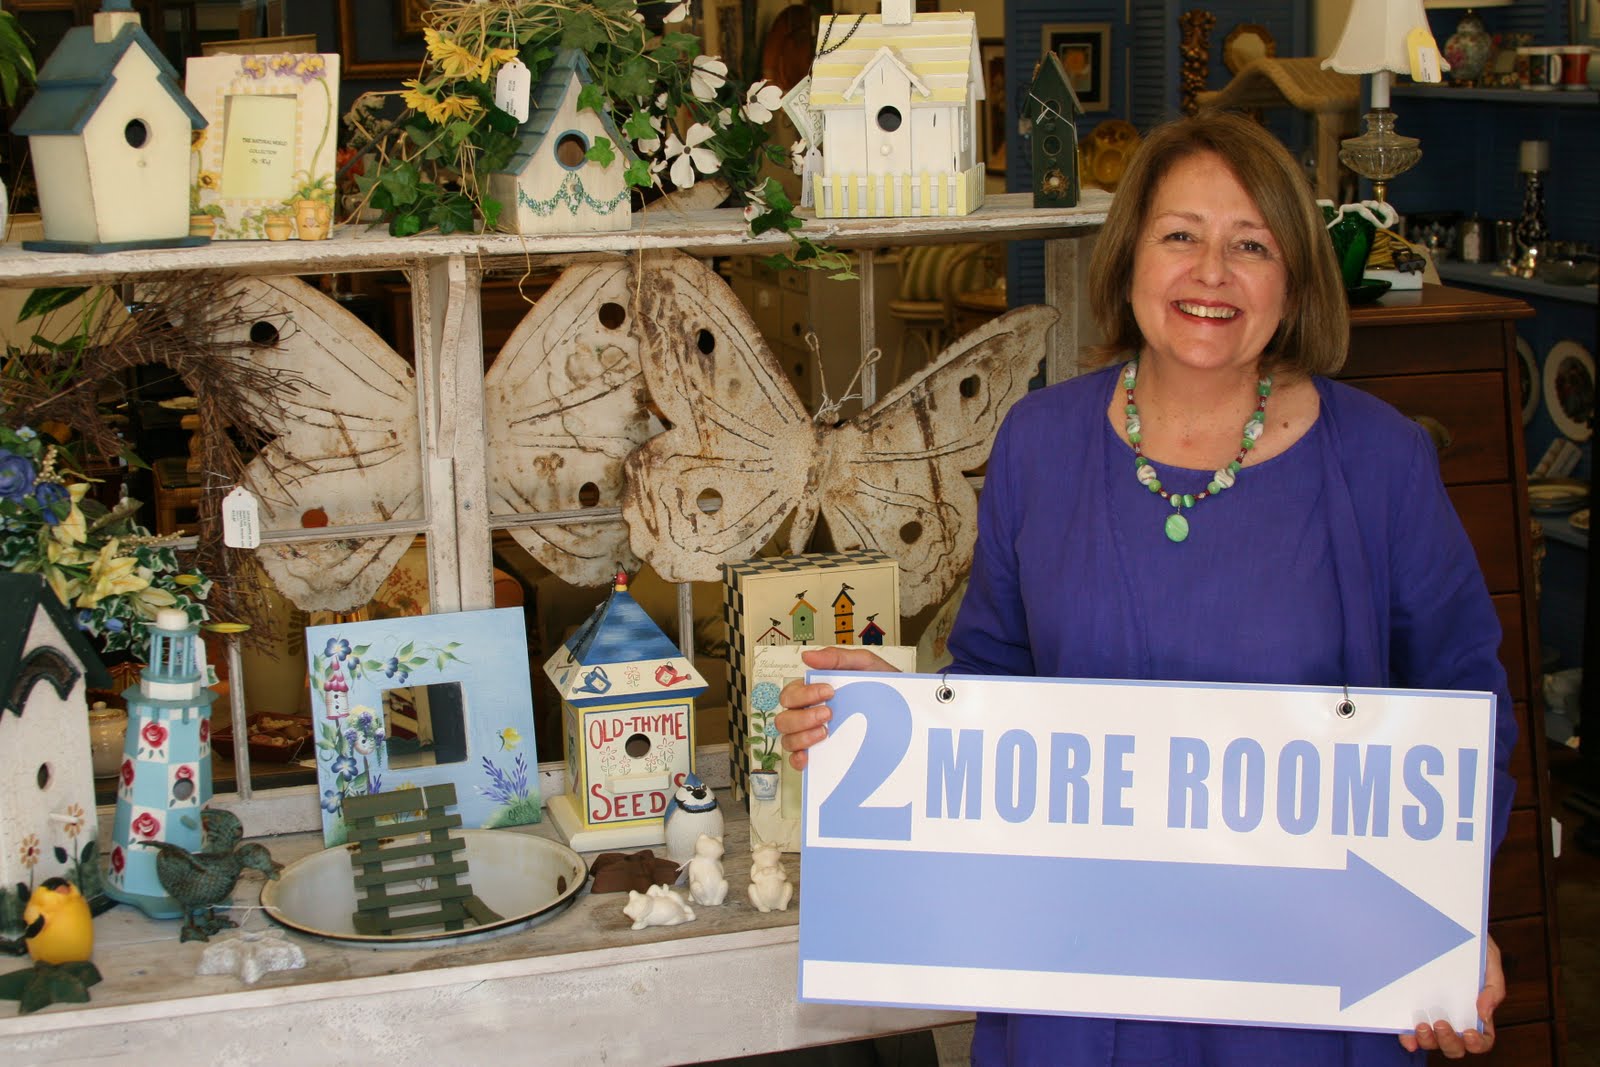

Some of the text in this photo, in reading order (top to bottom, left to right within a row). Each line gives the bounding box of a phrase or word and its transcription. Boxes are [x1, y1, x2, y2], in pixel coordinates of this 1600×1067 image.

[589, 712, 687, 749] OLD-THYME
[818, 681, 1478, 841] 2 MORE ROOMS!
